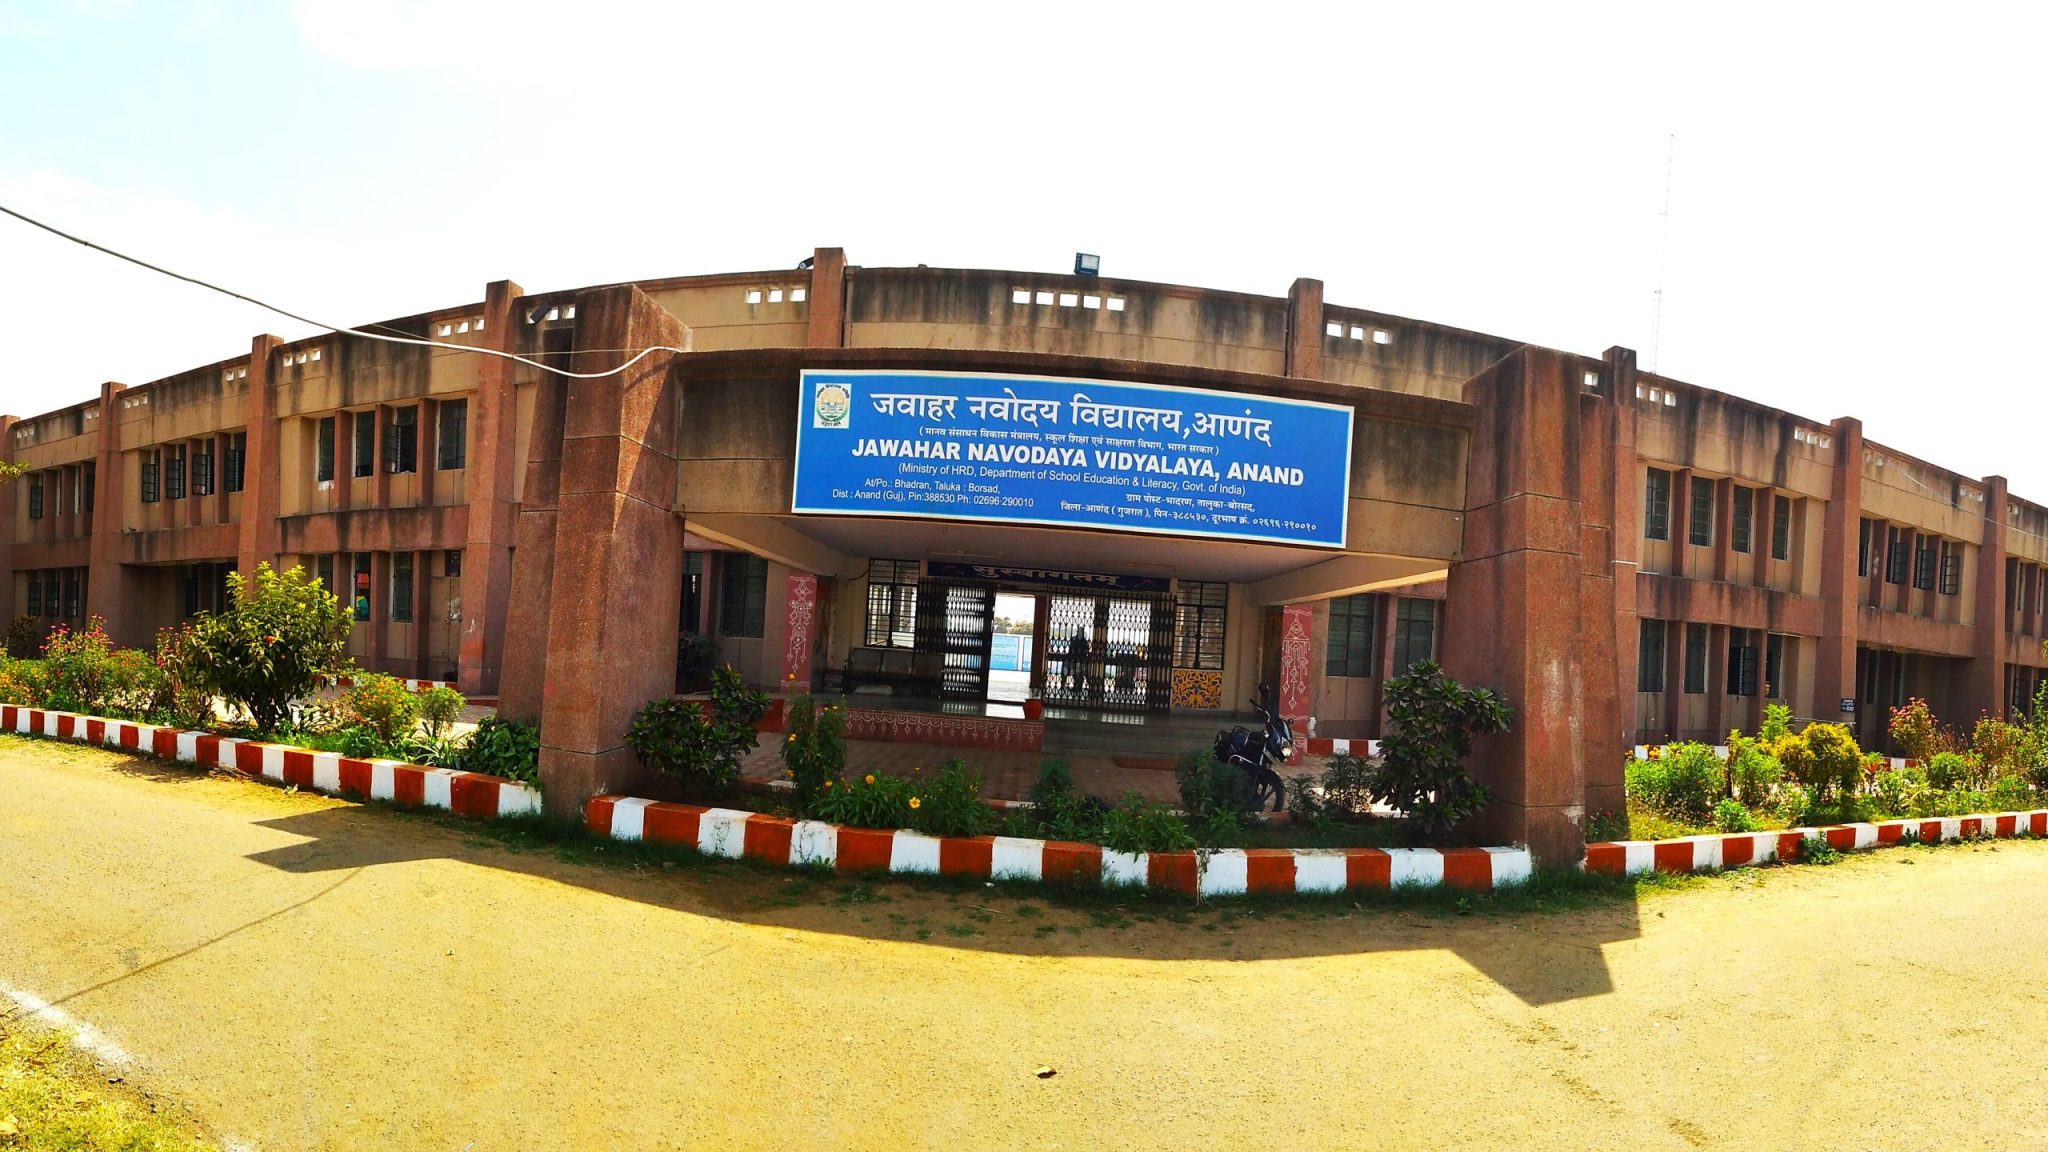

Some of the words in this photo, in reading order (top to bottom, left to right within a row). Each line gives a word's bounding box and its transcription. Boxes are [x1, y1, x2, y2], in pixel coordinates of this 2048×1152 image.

[870, 393, 958, 421] जवाहर
[966, 387, 1061, 428] नवोदय
[948, 427, 977, 438] संसाधन
[980, 427, 1008, 438] विकास
[1010, 430, 1042, 441] मंत्रालय,
[1045, 433, 1066, 444] स्कूल
[1068, 433, 1089, 444] शिक्षा
[1091, 435, 1103, 446] एवं
[1106, 437, 1135, 448] साक्षरता
[1138, 438, 1165, 451] विभाग,
[1167, 442, 1187, 452] भारत
[851, 438, 961, 461] JAWAHAR
[968, 443, 1088, 467] NAVODAYA
[1094, 450, 1221, 482] VIDYALAYA,
[1226, 462, 1305, 487] ANAND
[894, 479, 932, 491] Bhadran,
[934, 481, 961, 492] Taluka
[968, 483, 1001, 494] Borsad,
[899, 463, 938, 476] (Ministry
[940, 465, 950, 475] of
[951, 466, 977, 477] HRD,
[980, 467, 1035, 480] Department
[1038, 470, 1047, 480] of
[1049, 471, 1081, 483] School
[1083, 473, 1130, 486] Education
[1132, 477, 1139, 487] &
[1142, 477, 1179, 491] Literacy,
[1182, 481, 1206, 493] Govt.
[1208, 482, 1217, 493] of
[1219, 483, 1246, 496] India)
[832, 488, 848, 499] Dist
[854, 489, 881, 499] Anand
[883, 490, 906, 502] (Guj),
[957, 494, 972, 504] Ph:
[973, 495, 1034, 507] 02696-290010
[1126, 493, 1141, 503] ग्राम
[1118, 506, 1144, 518] गुजरात
[972, 565, 1126, 589] सुस्वागतम्
